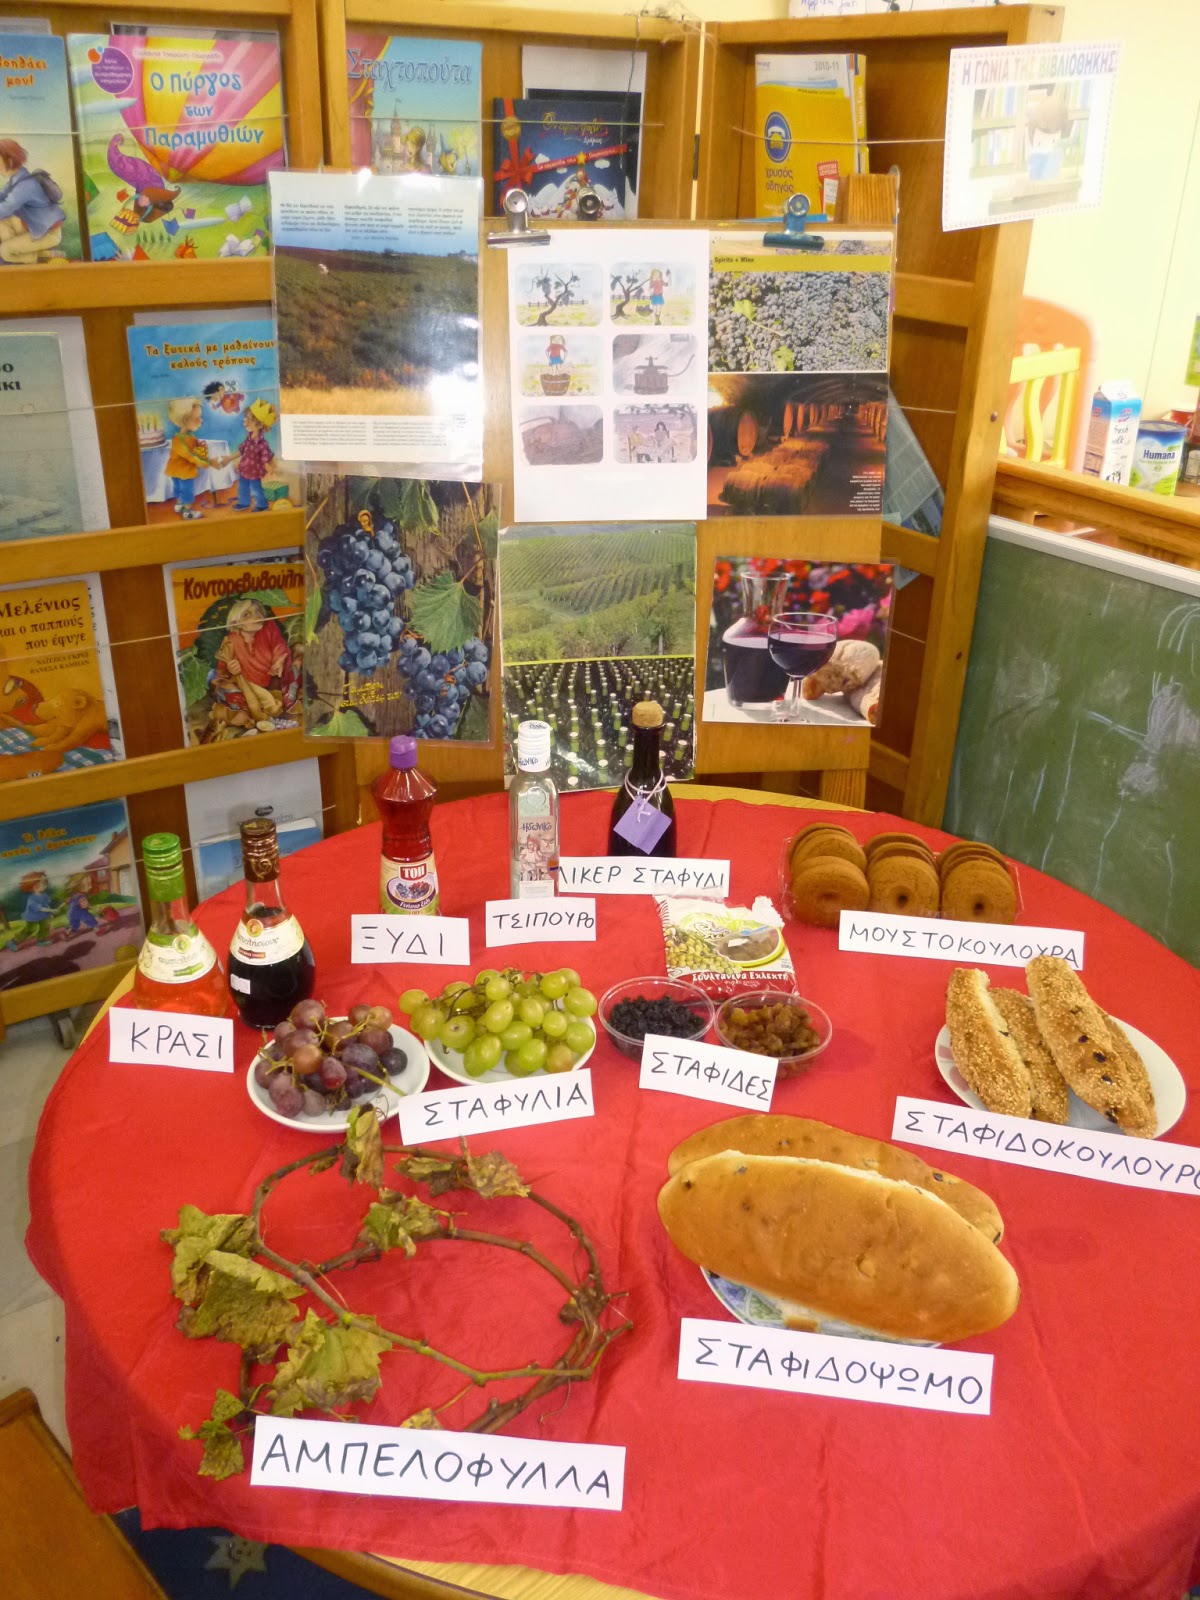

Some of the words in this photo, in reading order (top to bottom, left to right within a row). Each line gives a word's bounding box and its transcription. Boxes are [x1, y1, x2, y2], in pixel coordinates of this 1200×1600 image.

[346, 48, 472, 92] Σταχτοπούτα
[814, 60, 840, 71] 2010-11
[962, 62, 971, 85] Η
[974, 58, 1009, 83] ΓΩΝΙΑ
[1014, 57, 1036, 80] ΤΗΣ
[1039, 50, 1116, 78] ΒΙΒΛΙΟΘΗΚΗΣ
[150, 71, 164, 91] Ο
[170, 71, 242, 97] Πύργος
[144, 125, 265, 151] Παραμυθιών
[765, 167, 793, 181] χρυσός
[765, 181, 794, 194] οδηγός
[714, 256, 734, 264] Spirits
[145, 345, 159, 356] Τα
[163, 342, 201, 356] ξωτικά
[206, 344, 218, 355] με
[170, 357, 208, 370] καλούς
[212, 356, 256, 369] τρόπους
[1143, 449, 1176, 460] Humana
[30, 615, 84, 633] παππούς
[26, 639, 48, 651] που
[52, 633, 86, 648] έφυγε
[632, 866, 725, 889] ΣΤΑΦΥΛΙ
[492, 911, 595, 930] ΤΣΙΠΟΥΡΟ
[361, 926, 443, 956] ΞΥΔΙ
[849, 923, 1080, 969] ΜΟΥΣΤΟΚΟΥΛΟΥΡΑ
[130, 1021, 223, 1059] ΚΡΑΣΙ
[650, 1051, 772, 1102] ΣΤΑΦΙΔΕΣ
[424, 1082, 588, 1127] ΣΤΑΦΥΛΙΑ
[695, 1337, 983, 1405] ΣΤΑΦΙΔΟΨΩΜΟ
[260, 1433, 610, 1499] ΑΜΠΕΛΟΦΥΛΛΑ
